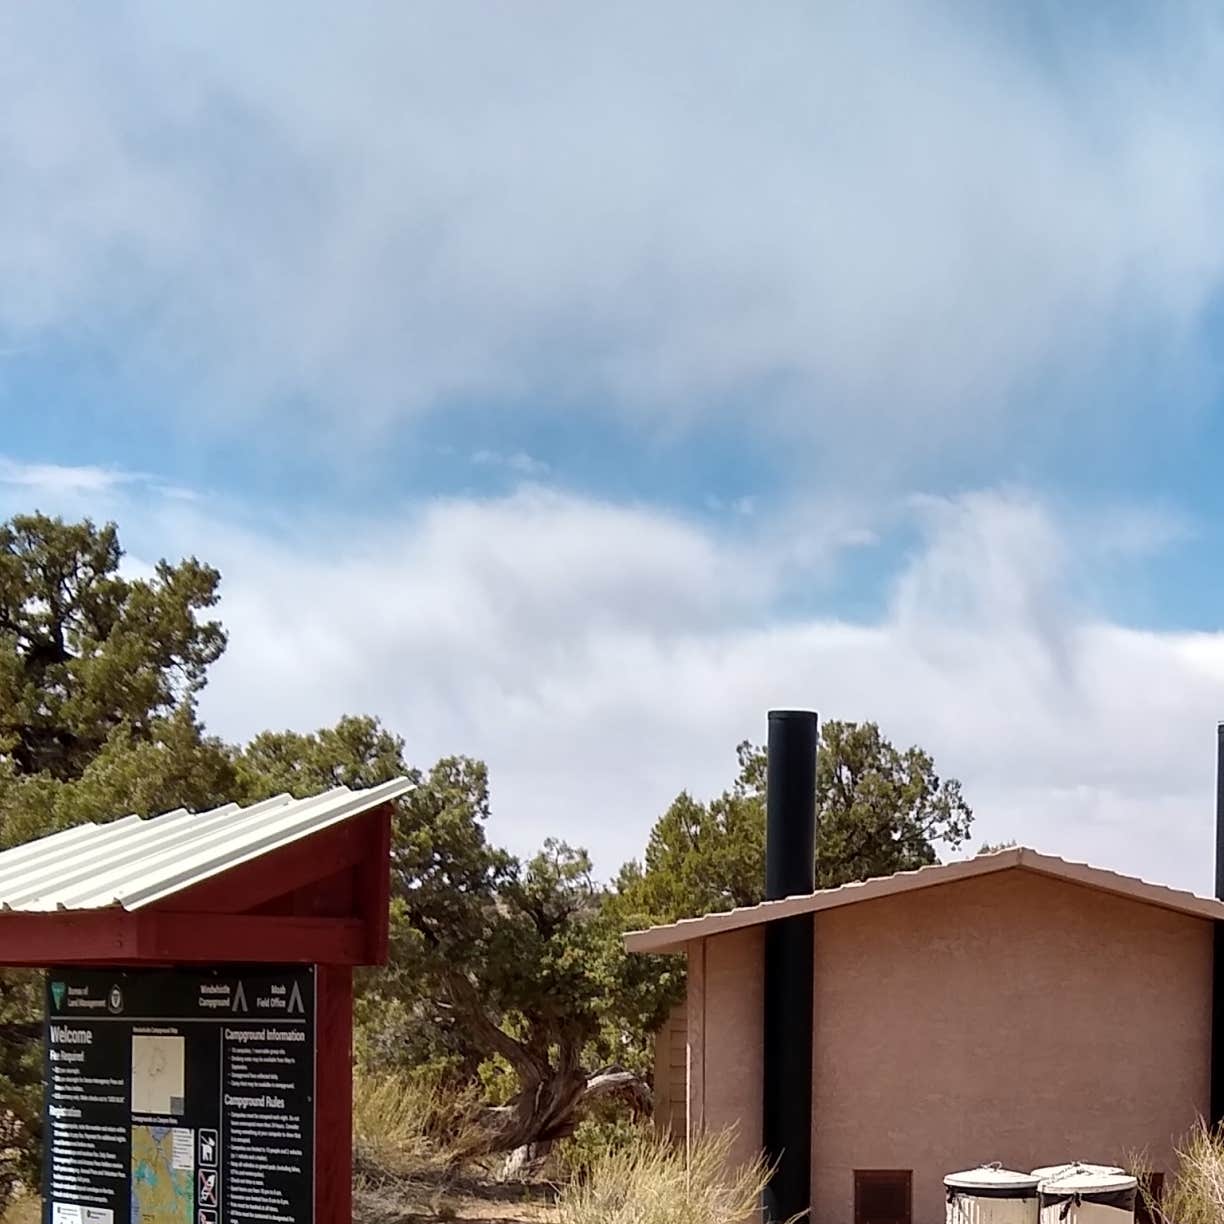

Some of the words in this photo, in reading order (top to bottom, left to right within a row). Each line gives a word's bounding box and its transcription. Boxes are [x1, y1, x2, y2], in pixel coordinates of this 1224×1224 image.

[50, 1025, 93, 1044] Welcome
[224, 1028, 265, 1044] Campground
[266, 1028, 305, 1042] Information
[224, 1094, 265, 1109] Campground
[266, 1095, 285, 1109] Rules
